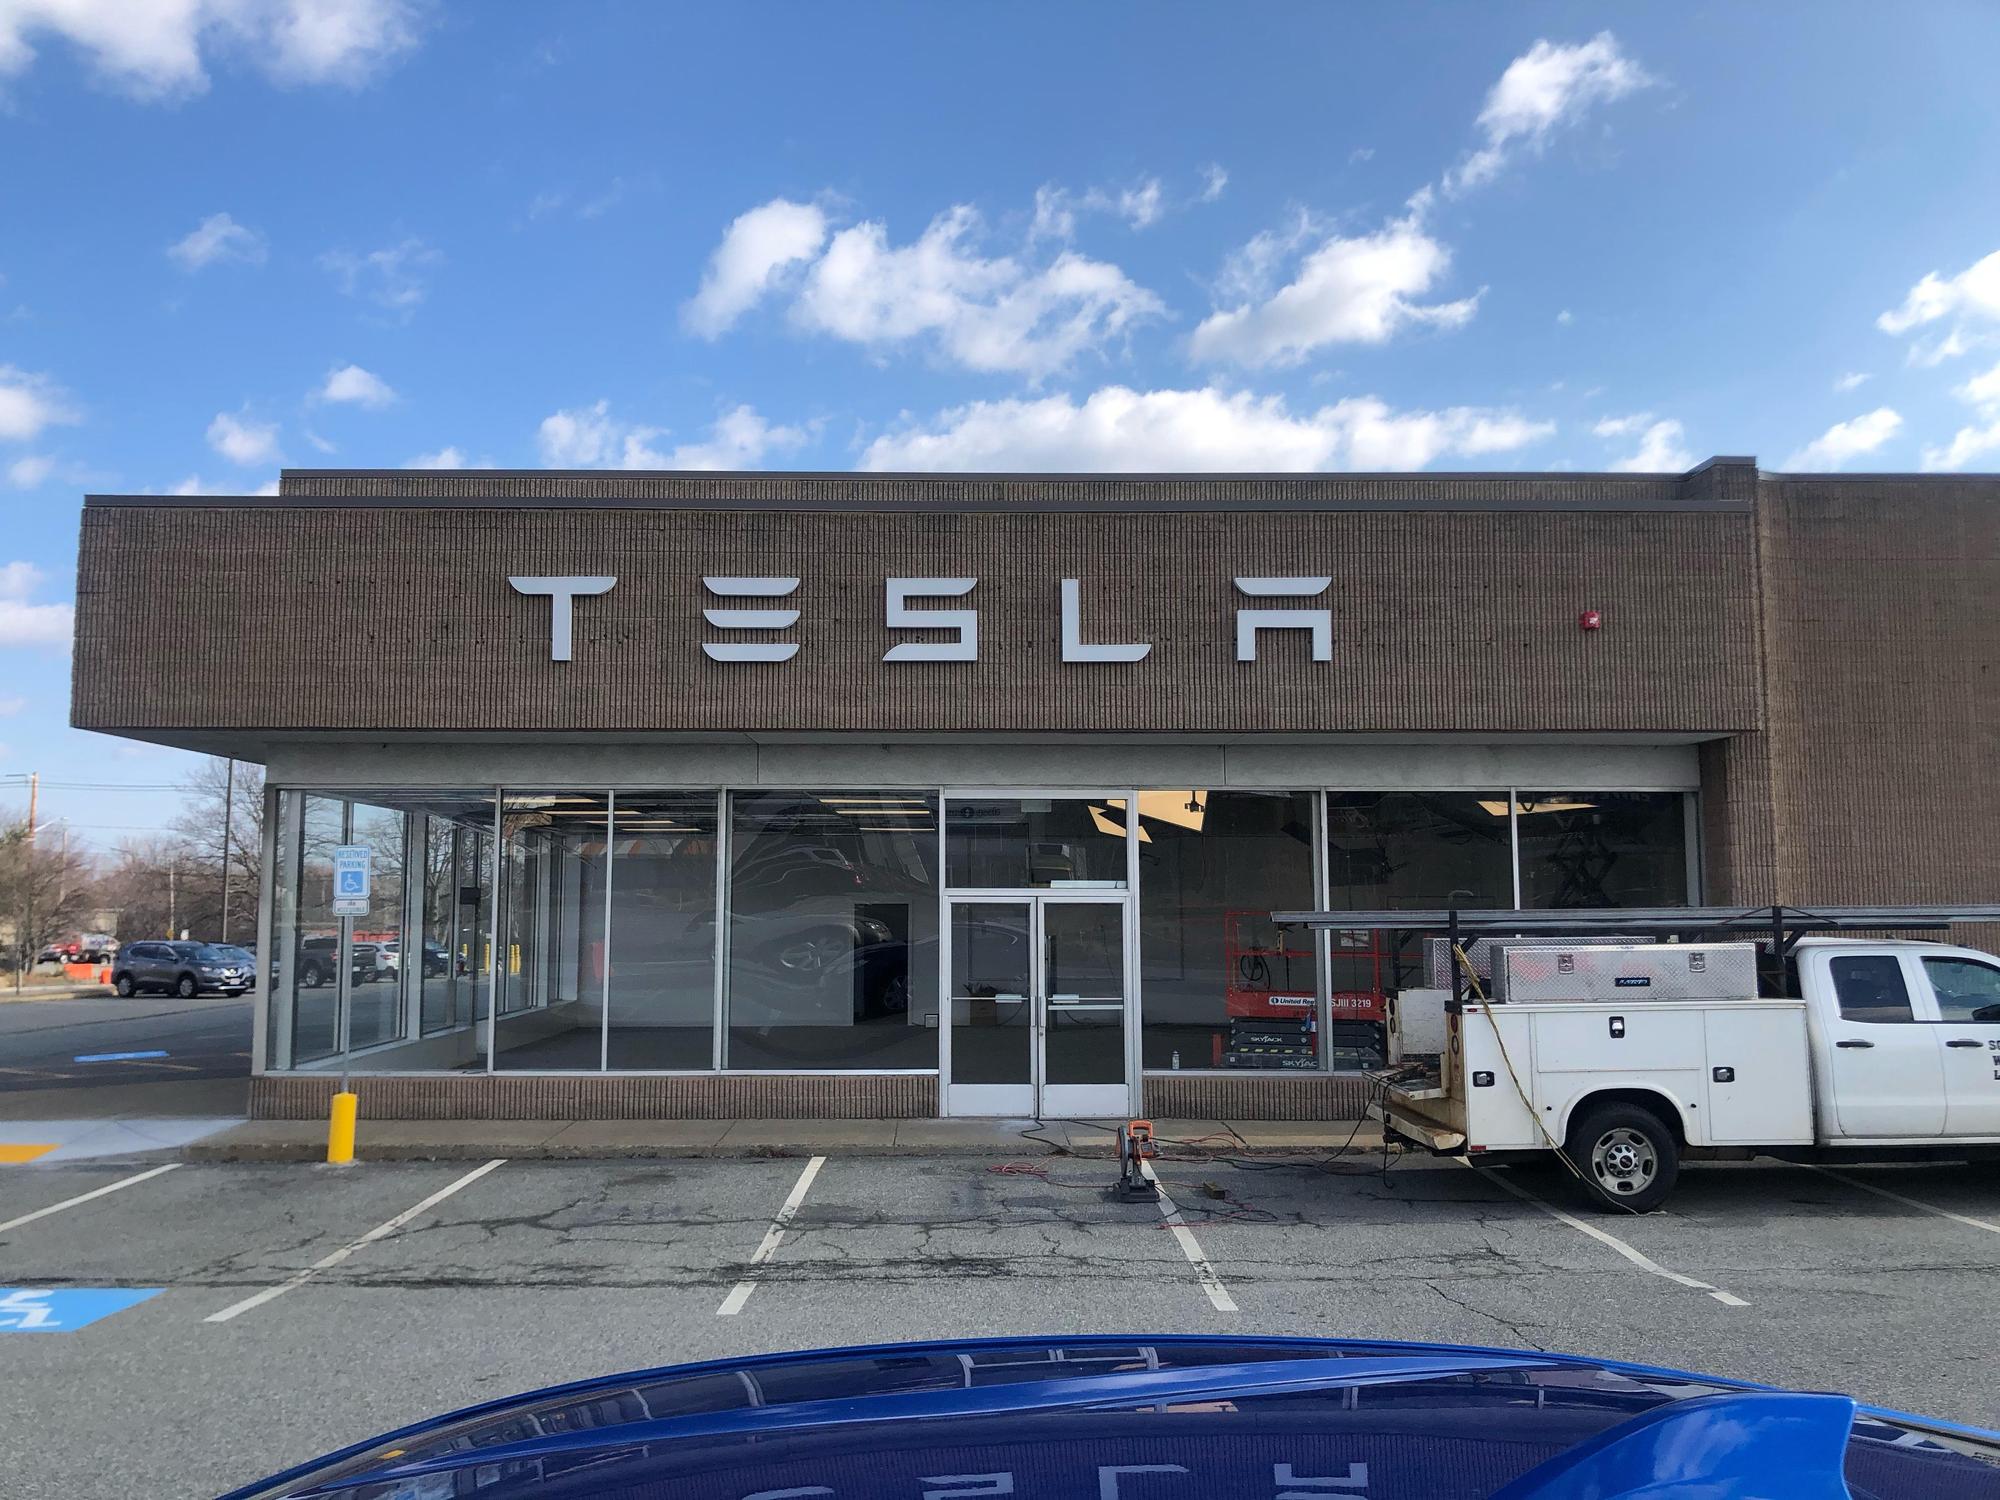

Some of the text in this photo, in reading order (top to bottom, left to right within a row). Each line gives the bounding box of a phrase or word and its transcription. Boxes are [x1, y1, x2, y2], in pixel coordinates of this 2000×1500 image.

[507, 575, 1333, 662] TESLA
[338, 850, 368, 858] RESERVED
[339, 860, 366, 869] PARKING
[1279, 997, 1302, 1005] United
[1351, 999, 1372, 1008] 3219
[1250, 1035, 1283, 1043] SKYJACK
[1281, 1058, 1318, 1068] SKYJAC
